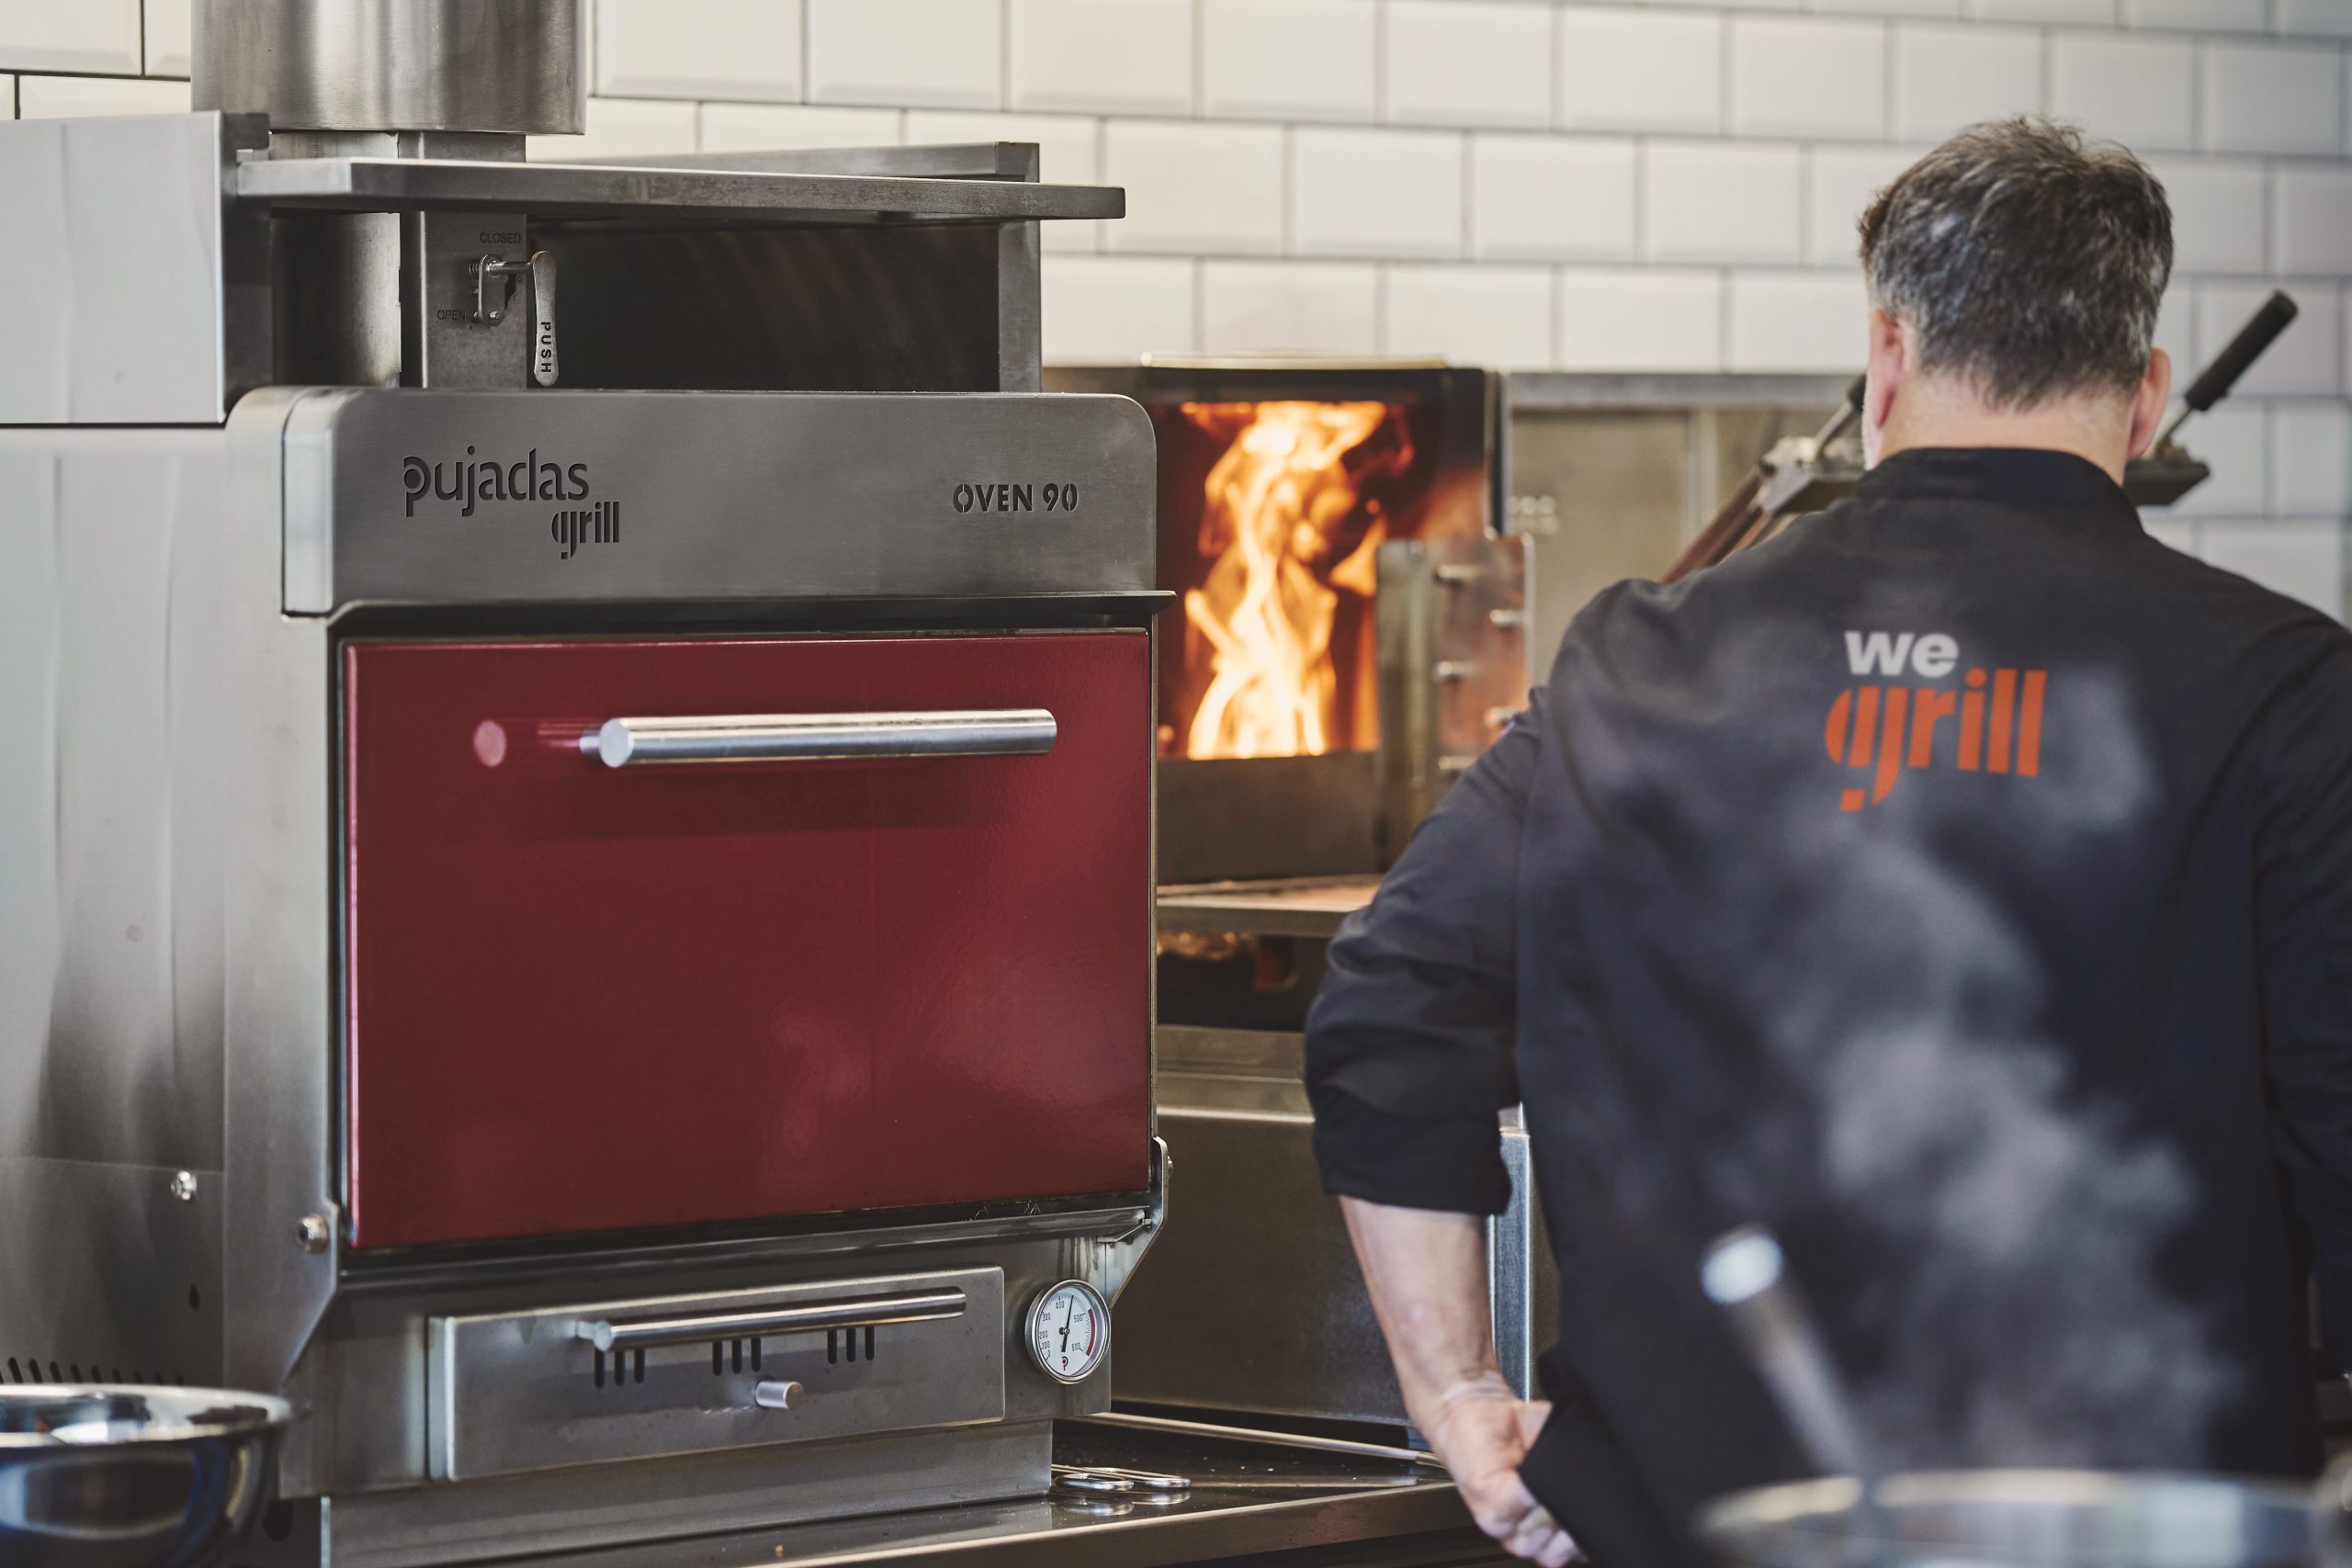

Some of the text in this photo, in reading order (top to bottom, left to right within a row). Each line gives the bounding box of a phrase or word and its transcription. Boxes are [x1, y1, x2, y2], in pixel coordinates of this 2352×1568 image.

[480, 232, 521, 243] CLOSED
[437, 309, 466, 321] OPEN
[540, 321, 552, 373] PUSH
[403, 445, 590, 517] pujadas
[953, 482, 1078, 513] OVEN 90
[551, 501, 619, 559] grill
[1845, 630, 1959, 678] we
[1825, 667, 2048, 813] grill
[1055, 1300, 1065, 1309] 400
[1042, 1312, 1051, 1322] 300
[1073, 1314, 1083, 1323] 500
[1039, 1330, 1048, 1339] 200
[1041, 1340, 1050, 1349] 100
[1071, 1342, 1081, 1351] 600
